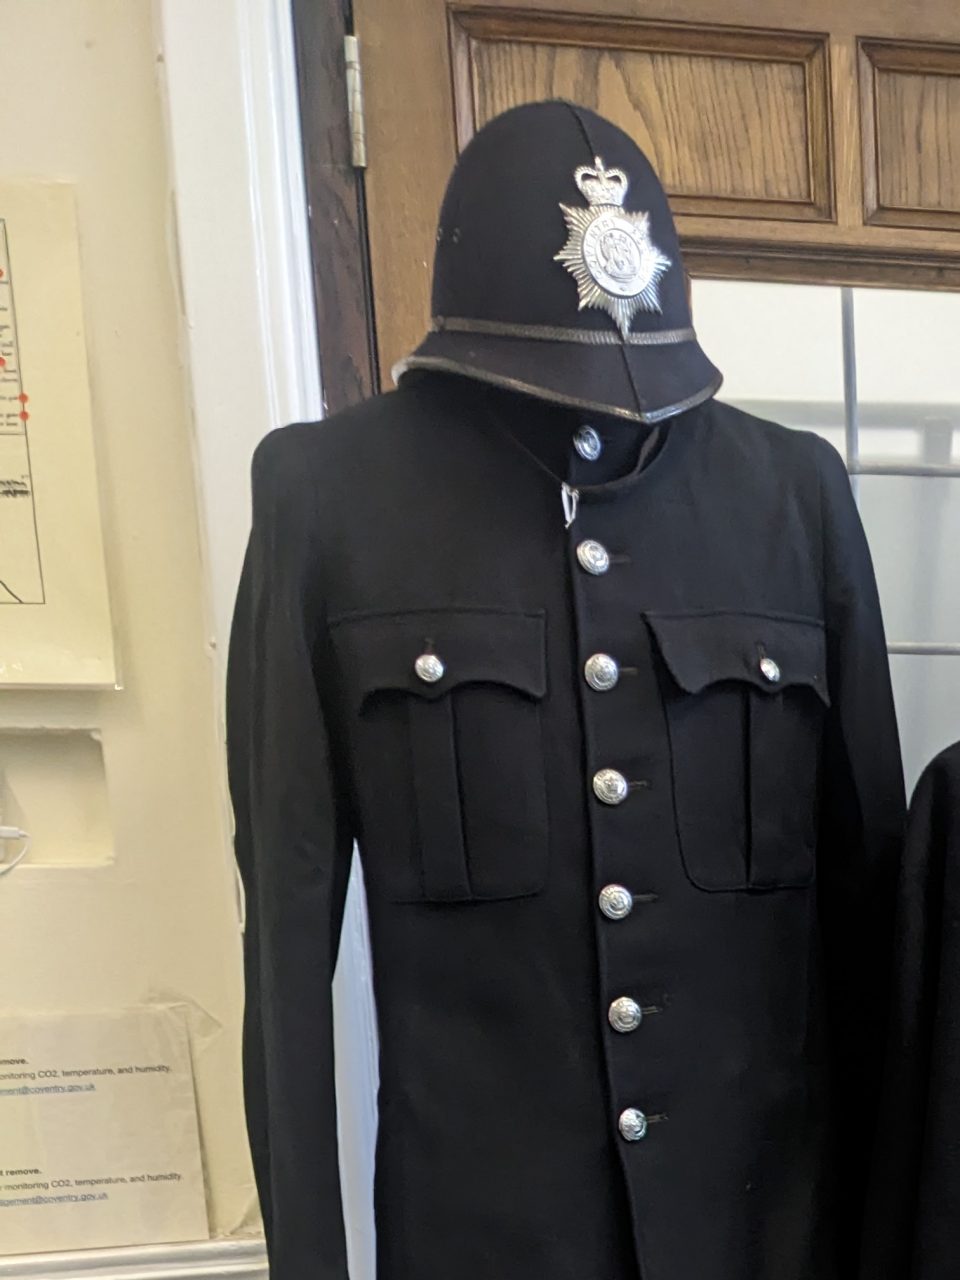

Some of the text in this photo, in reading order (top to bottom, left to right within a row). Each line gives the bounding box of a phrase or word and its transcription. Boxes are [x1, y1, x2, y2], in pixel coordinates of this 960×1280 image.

[62, 1068, 116, 1078] temperature,
[117, 1066, 133, 1074] and
[6, 1168, 43, 1176] remove.
[5, 1182, 49, 1191] monitoring
[75, 1177, 128, 1187] temperature,
[129, 1174, 145, 1183] and
